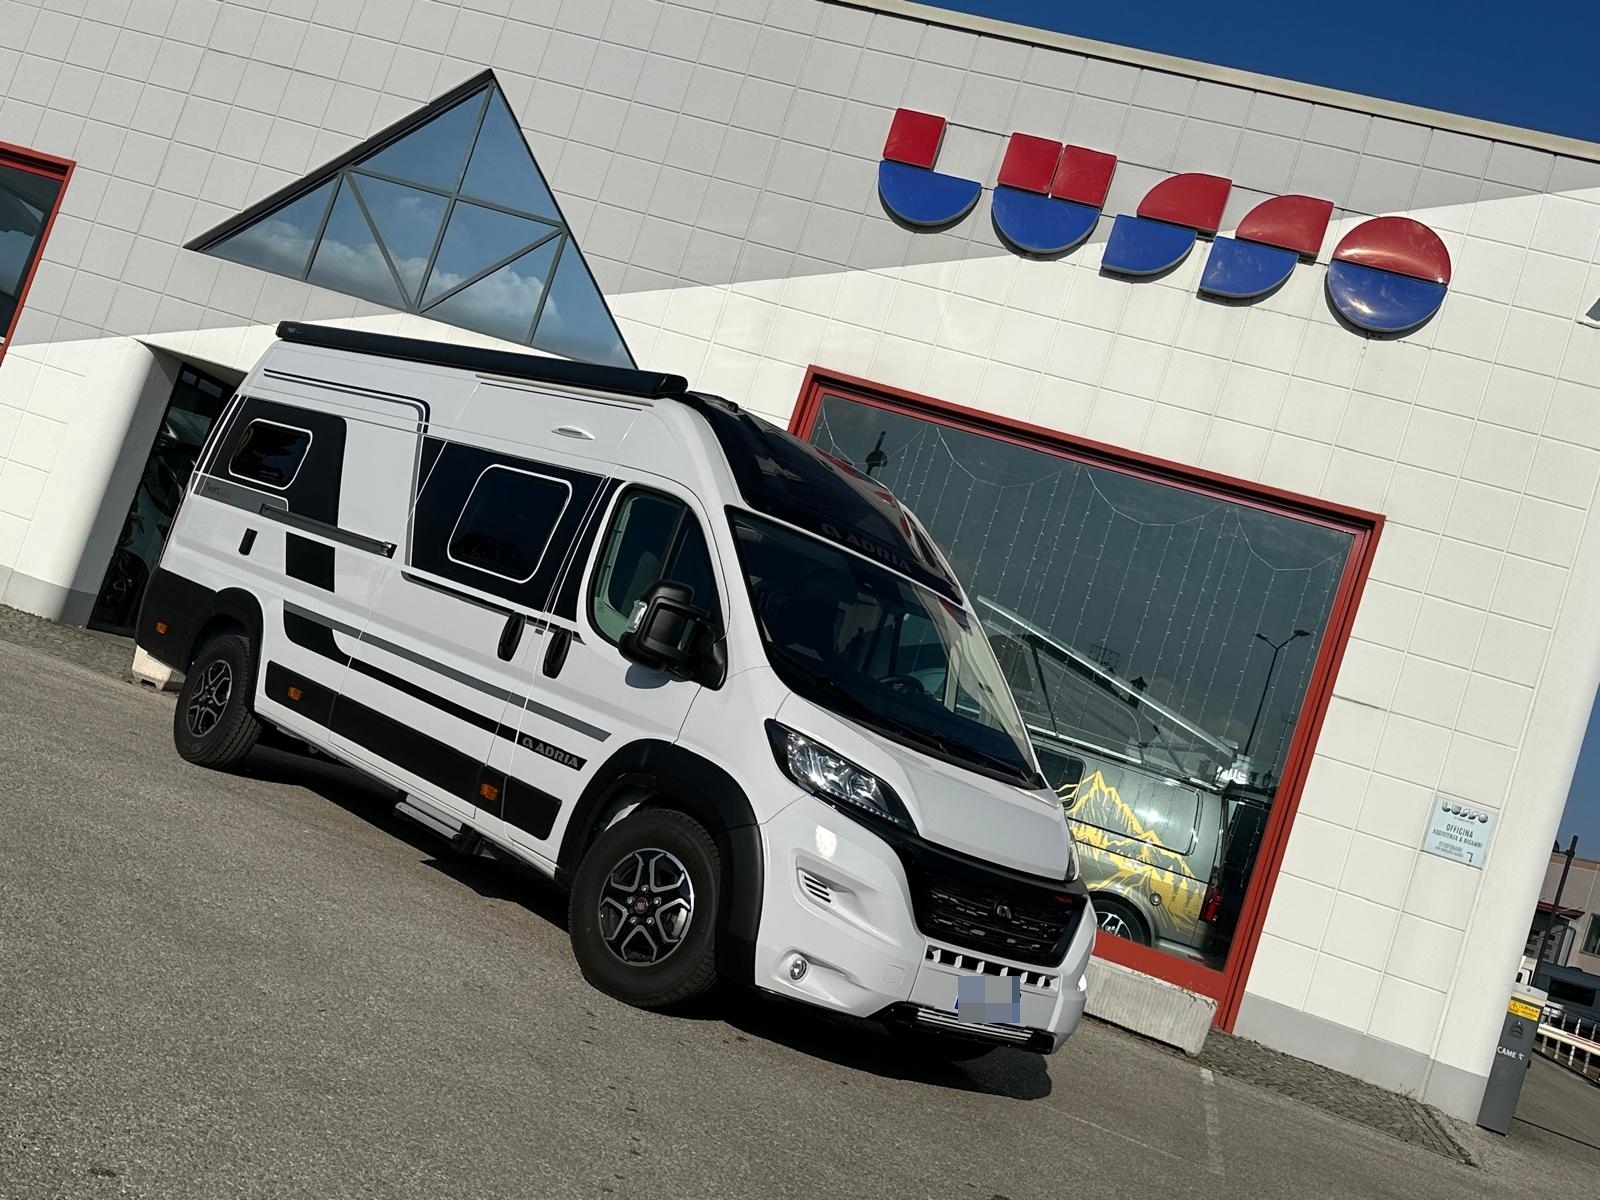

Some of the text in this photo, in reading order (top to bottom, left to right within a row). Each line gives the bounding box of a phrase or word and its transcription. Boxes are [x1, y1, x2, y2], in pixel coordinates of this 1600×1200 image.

[878, 108, 1452, 334] LUSSO
[845, 532, 912, 574] ADRIA
[535, 743, 578, 768] ADRIA
[1441, 801, 1489, 824] LUSSO
[1445, 823, 1474, 838] OFFICINA
[1497, 1046, 1517, 1059] CAME
